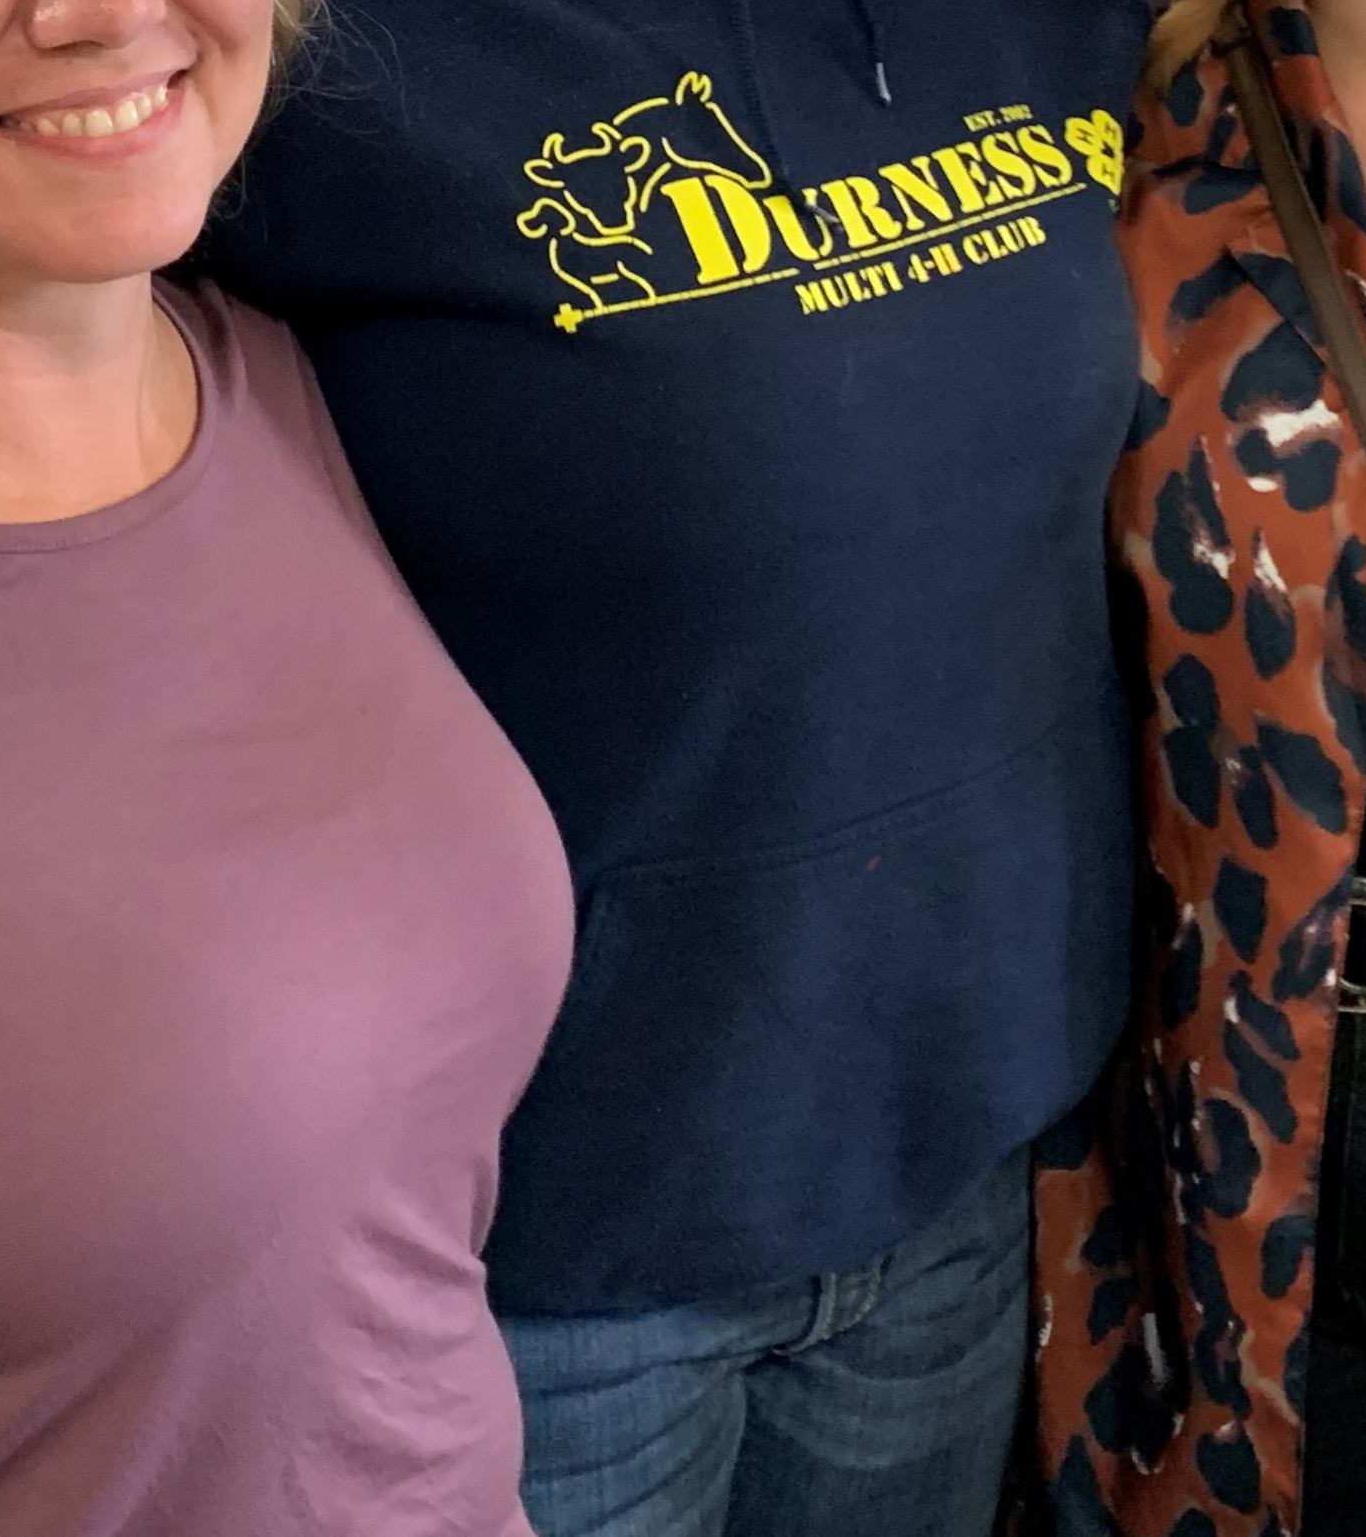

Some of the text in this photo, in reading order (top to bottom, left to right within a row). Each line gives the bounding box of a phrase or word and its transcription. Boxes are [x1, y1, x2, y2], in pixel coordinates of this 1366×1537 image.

[794, 216, 1047, 315] MULTI 4-H CLUB
